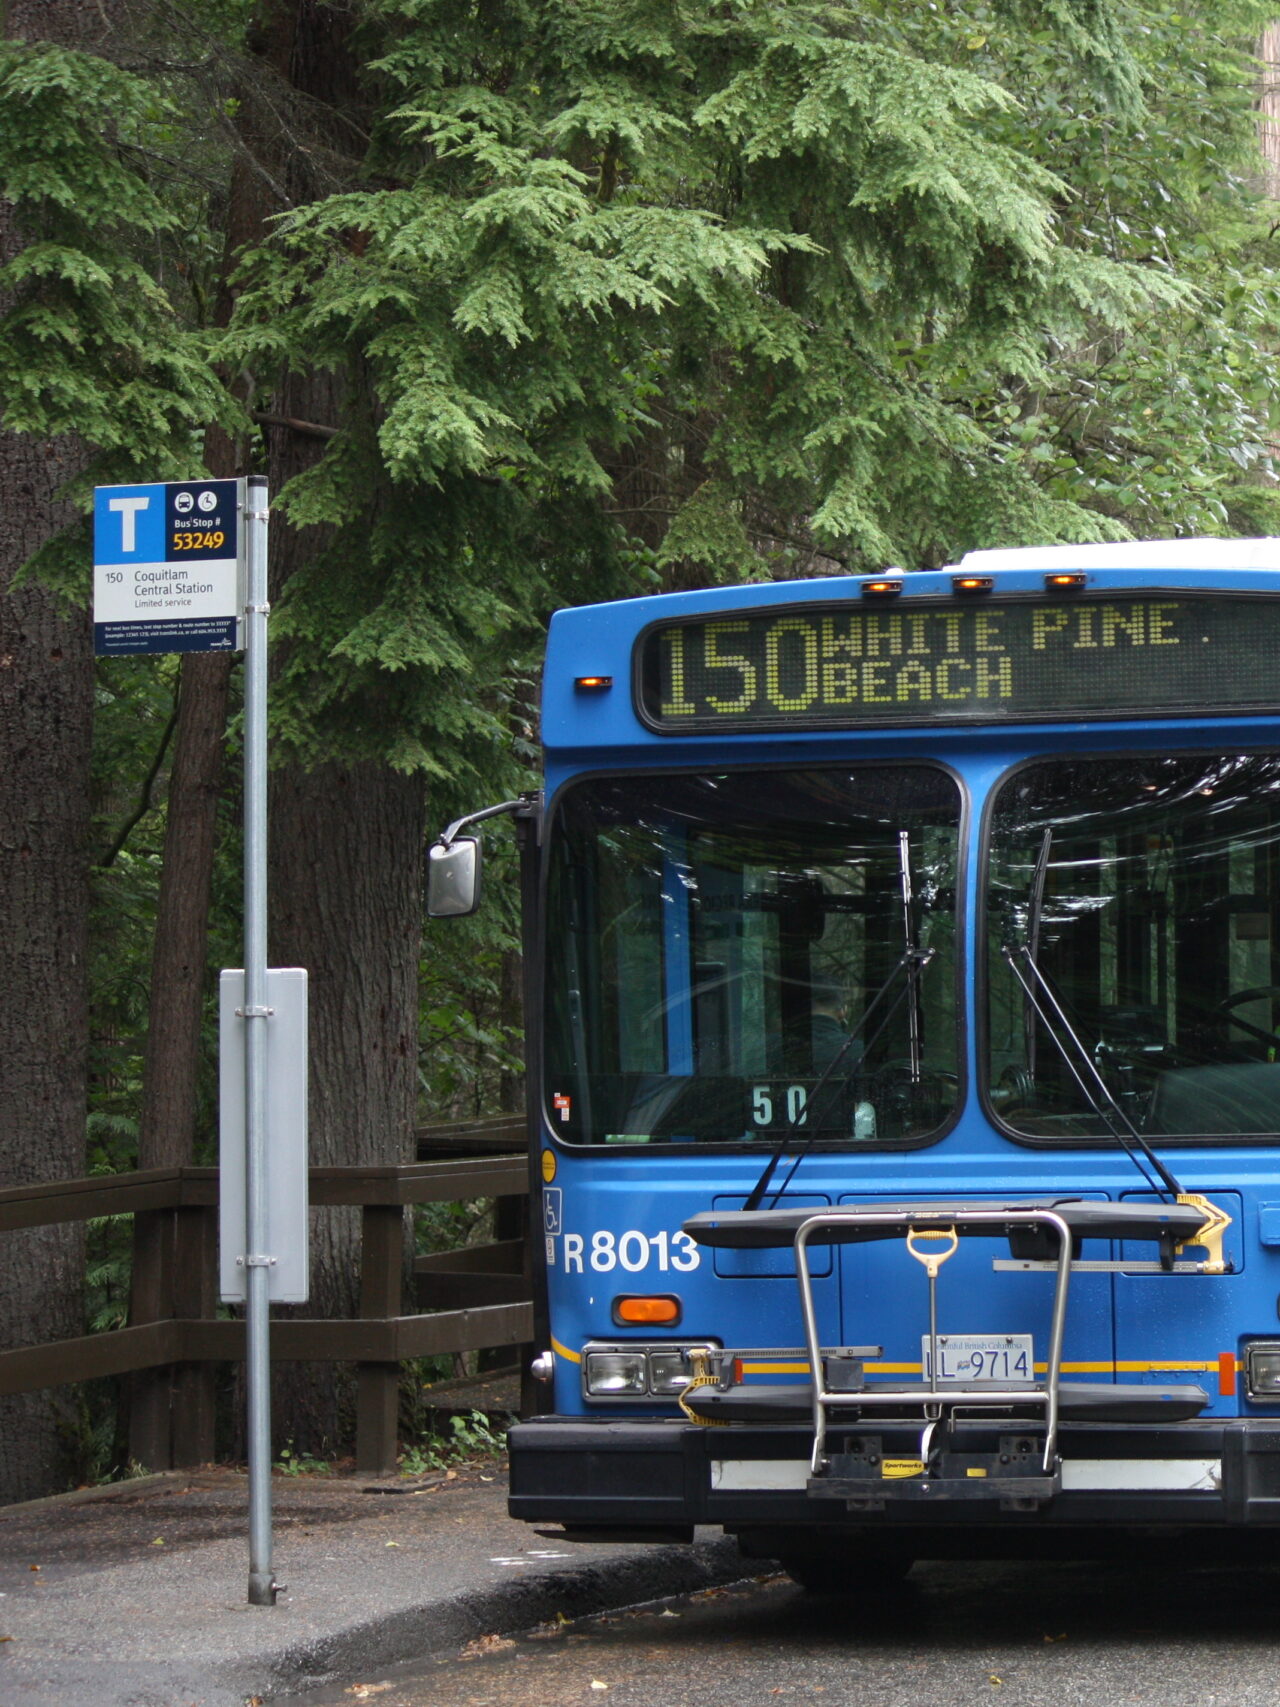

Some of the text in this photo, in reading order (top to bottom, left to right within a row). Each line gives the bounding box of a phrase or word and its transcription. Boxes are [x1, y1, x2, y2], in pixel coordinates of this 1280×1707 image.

[109, 497, 149, 552] T
[174, 517, 221, 529] Bus Stop #
[173, 531, 225, 550] 53249
[105, 572, 123, 583] 150
[134, 569, 188, 585] Coquitlam
[134, 583, 213, 596] Central Station
[134, 598, 192, 608] Limited service
[661, 604, 1180, 714] 150 WHITE PINE
[823, 657, 1012, 703] BEACH
[970, 1350, 1028, 1377] 9714
